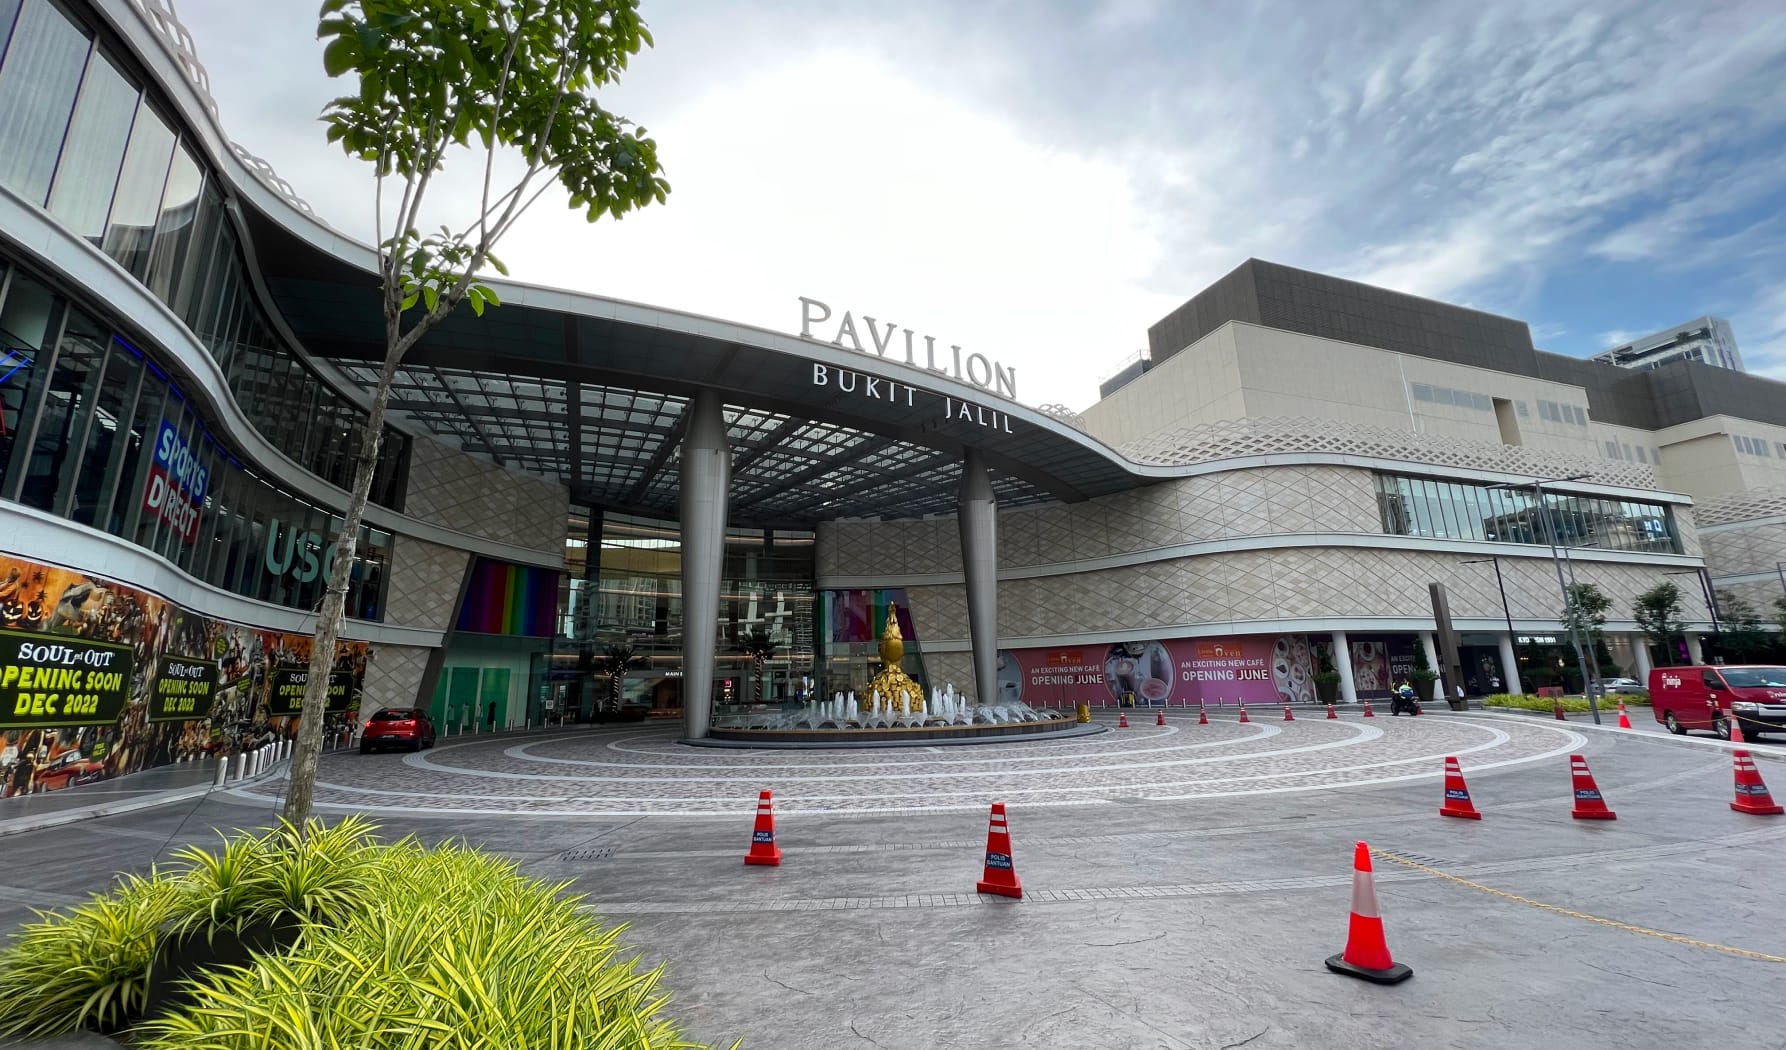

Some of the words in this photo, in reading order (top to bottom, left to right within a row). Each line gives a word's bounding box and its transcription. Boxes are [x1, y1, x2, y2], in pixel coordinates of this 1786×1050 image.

[799, 296, 1016, 400] PAVILION
[813, 363, 916, 406] BUKIT
[945, 397, 1013, 434] JALIL
[159, 428, 205, 496] SPORTS
[147, 474, 197, 536] DIRECT
[84, 649, 114, 667] OUT
[1192, 660, 1227, 668] EXCITING
[1229, 659, 1245, 667] NEW
[1041, 665, 1069, 674] EXCITING
[1070, 664, 1083, 673] NEW
[1182, 670, 1234, 681] OPENING
[1238, 669, 1269, 680] JUNE
[1392, 663, 1416, 674] OPEN
[0, 665, 82, 690] PENING
[85, 671, 122, 691] SOON
[290, 673, 308, 683] SOU
[1032, 675, 1074, 686] OPENING
[1077, 674, 1104, 684] JUNE
[159, 679, 187, 694] OPENING
[188, 681, 210, 695] SOON
[327, 685, 345, 695] OON
[14, 693, 59, 715] DEC
[63, 694, 99, 714] 2022
[163, 697, 177, 712] DEC
[177, 697, 195, 712] 2022
[986, 859, 1010, 867] BANTUAN
